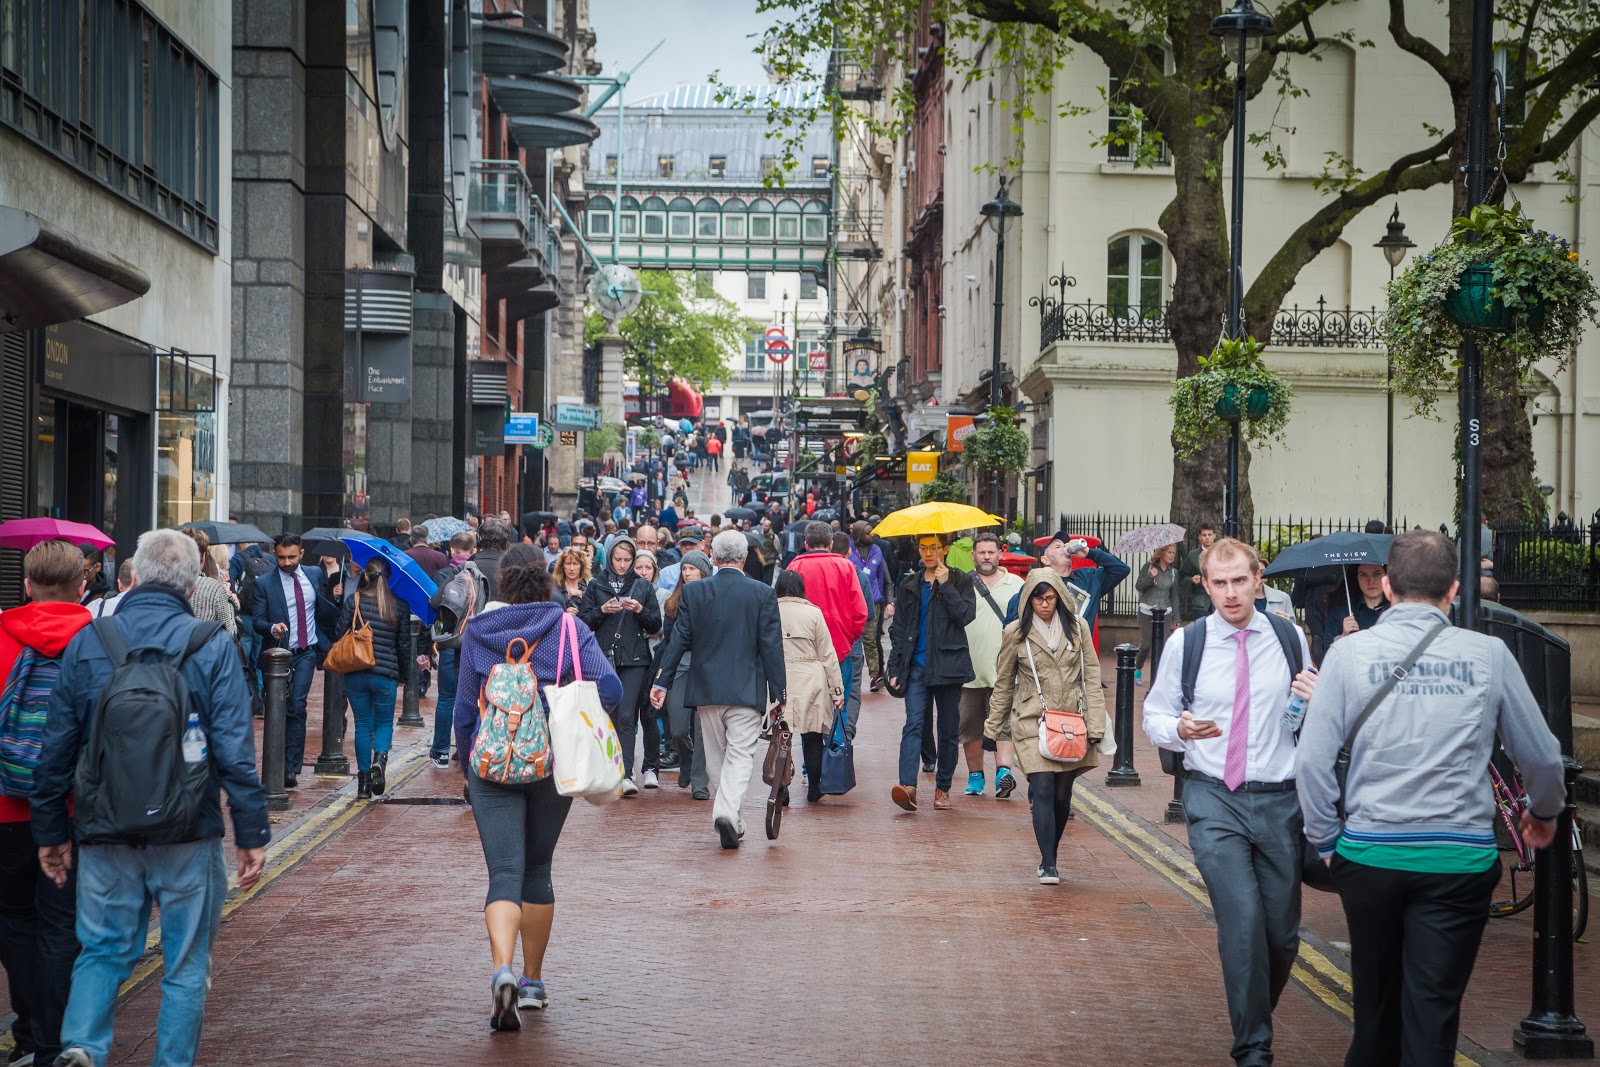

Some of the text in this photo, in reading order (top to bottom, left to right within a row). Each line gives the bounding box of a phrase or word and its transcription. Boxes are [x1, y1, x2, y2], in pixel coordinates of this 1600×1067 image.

[46, 338, 69, 365] ONDON
[368, 366, 380, 375] One
[368, 375, 405, 385] Embankment
[368, 384, 384, 393] Place
[1469, 418, 1480, 432] S
[1470, 433, 1480, 446] 3
[911, 463, 933, 473] EAT.
[1391, 683, 1465, 696] OLUTIONS
